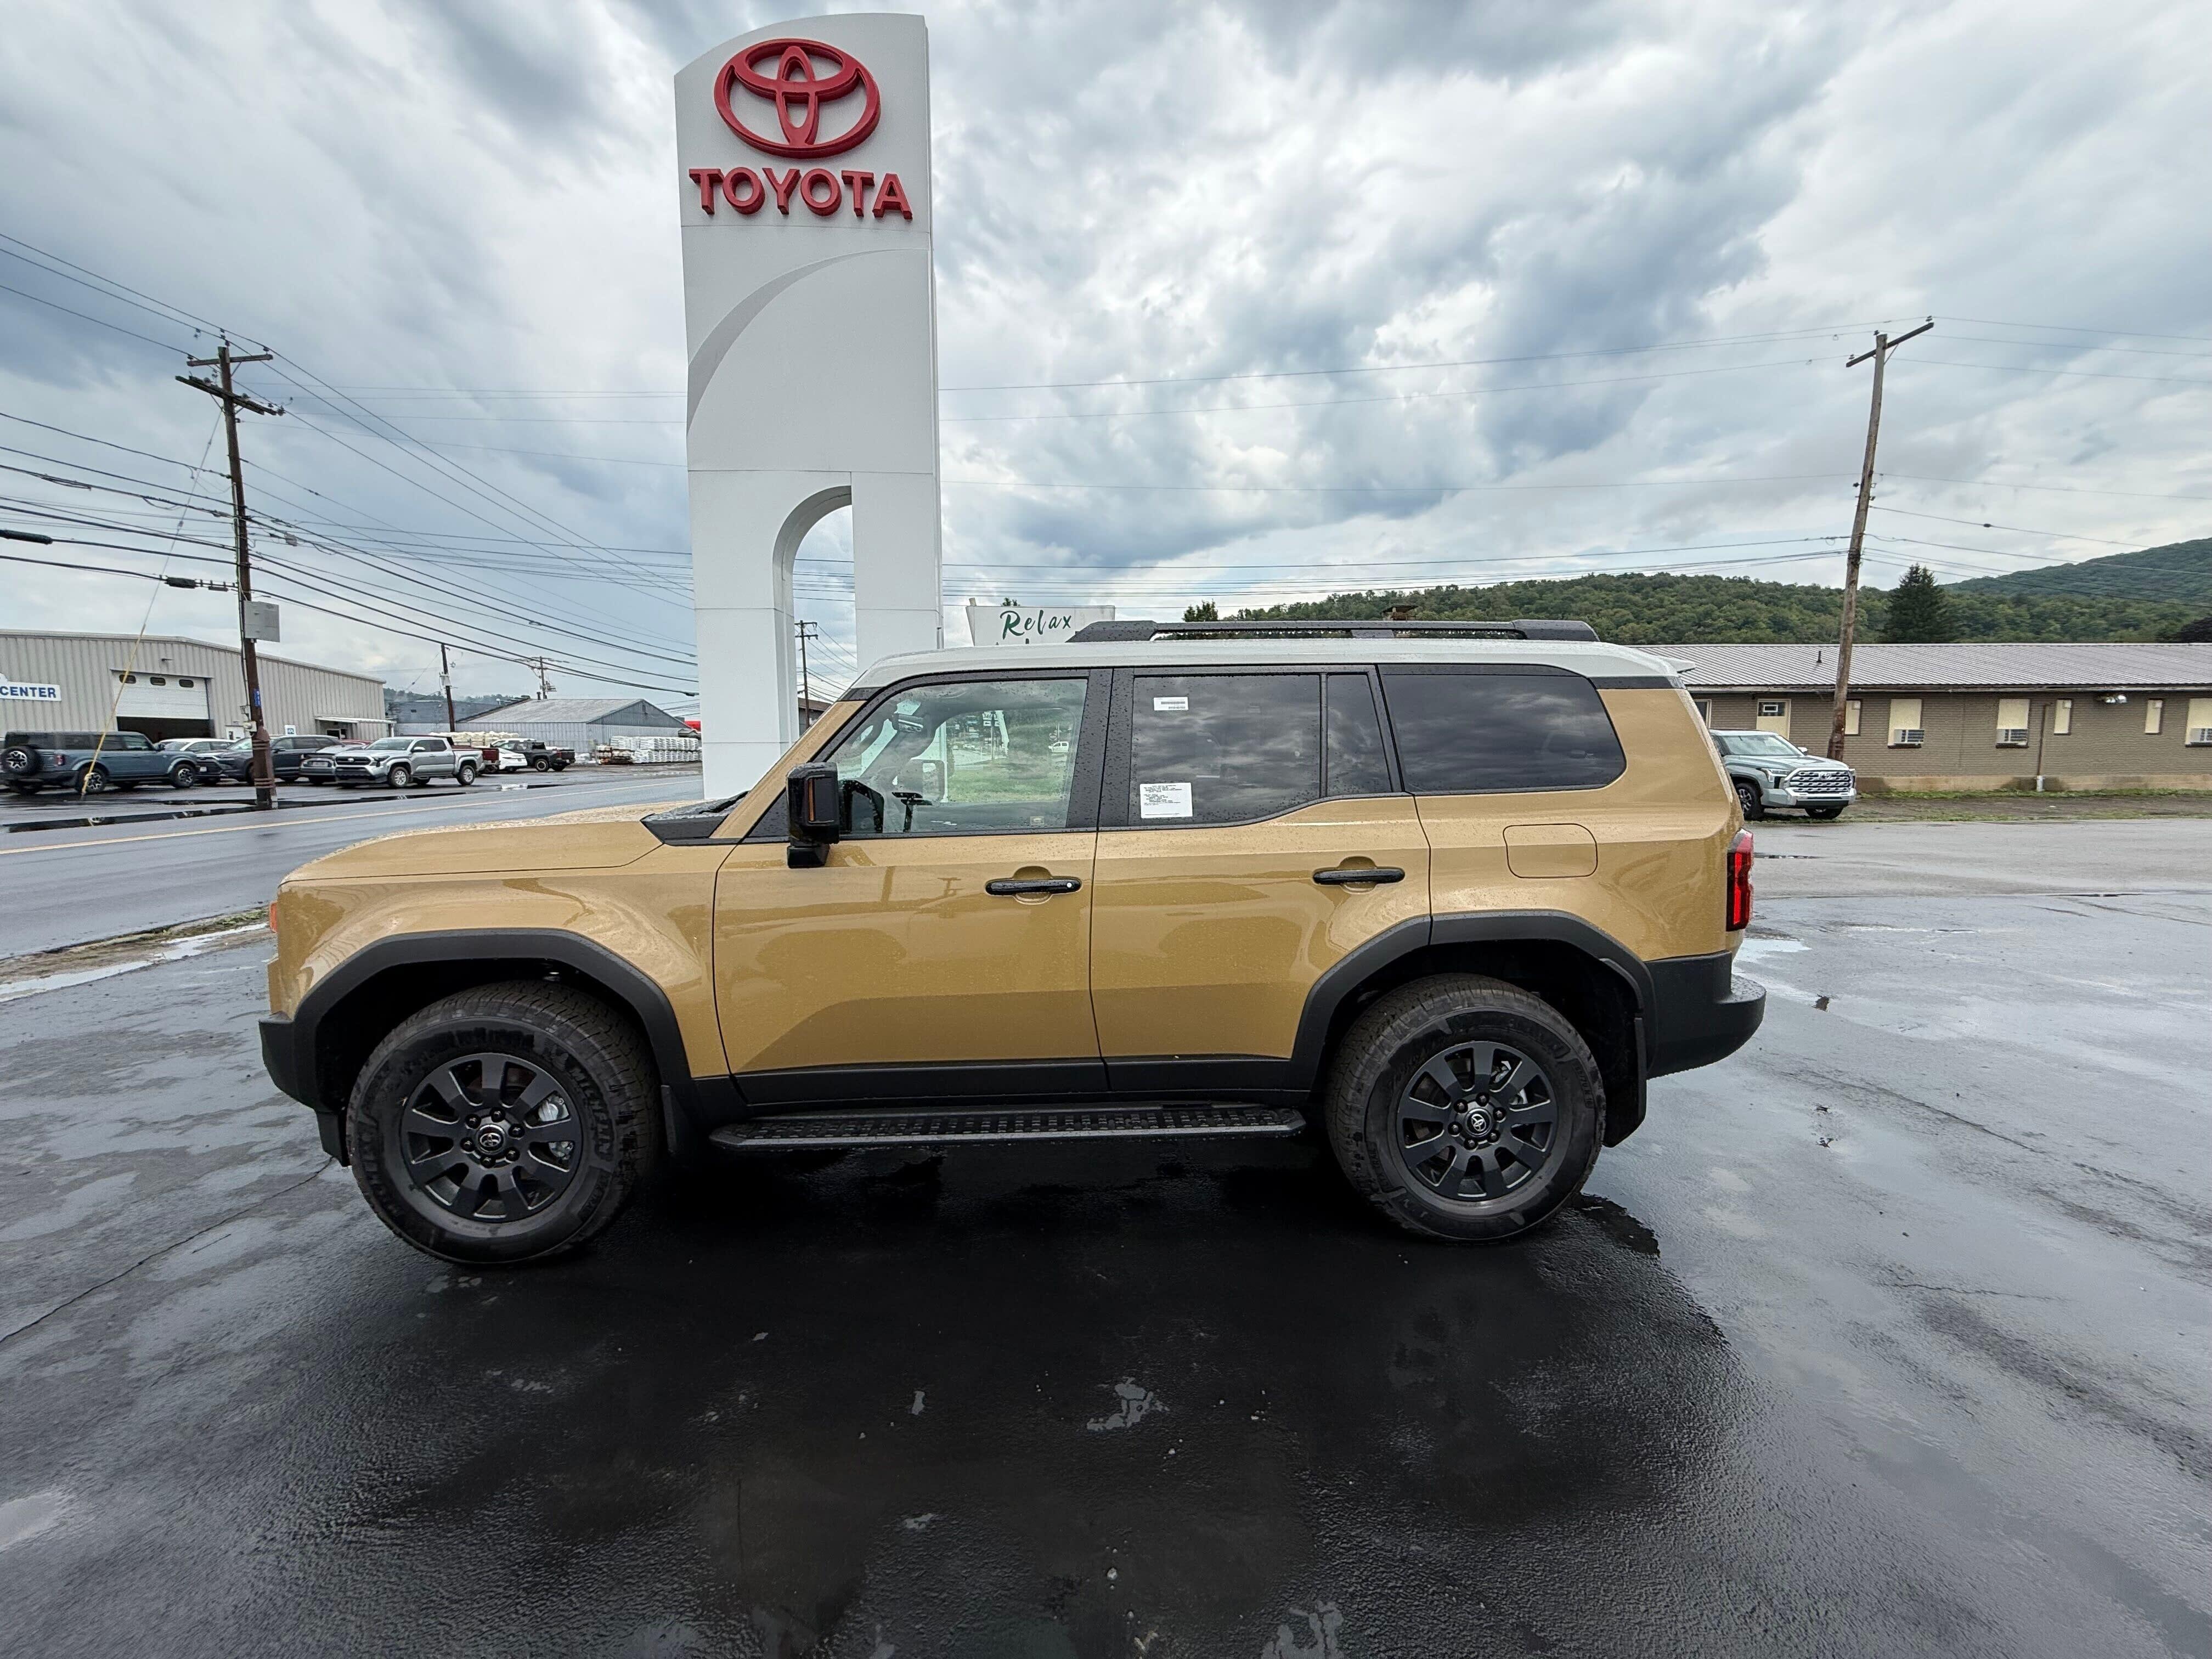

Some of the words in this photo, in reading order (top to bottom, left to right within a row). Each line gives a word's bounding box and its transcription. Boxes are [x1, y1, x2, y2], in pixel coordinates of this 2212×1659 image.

[689, 167, 913, 221] TOYOTA
[1000, 610, 1071, 640] Relax
[0, 686, 57, 698] CENTER
